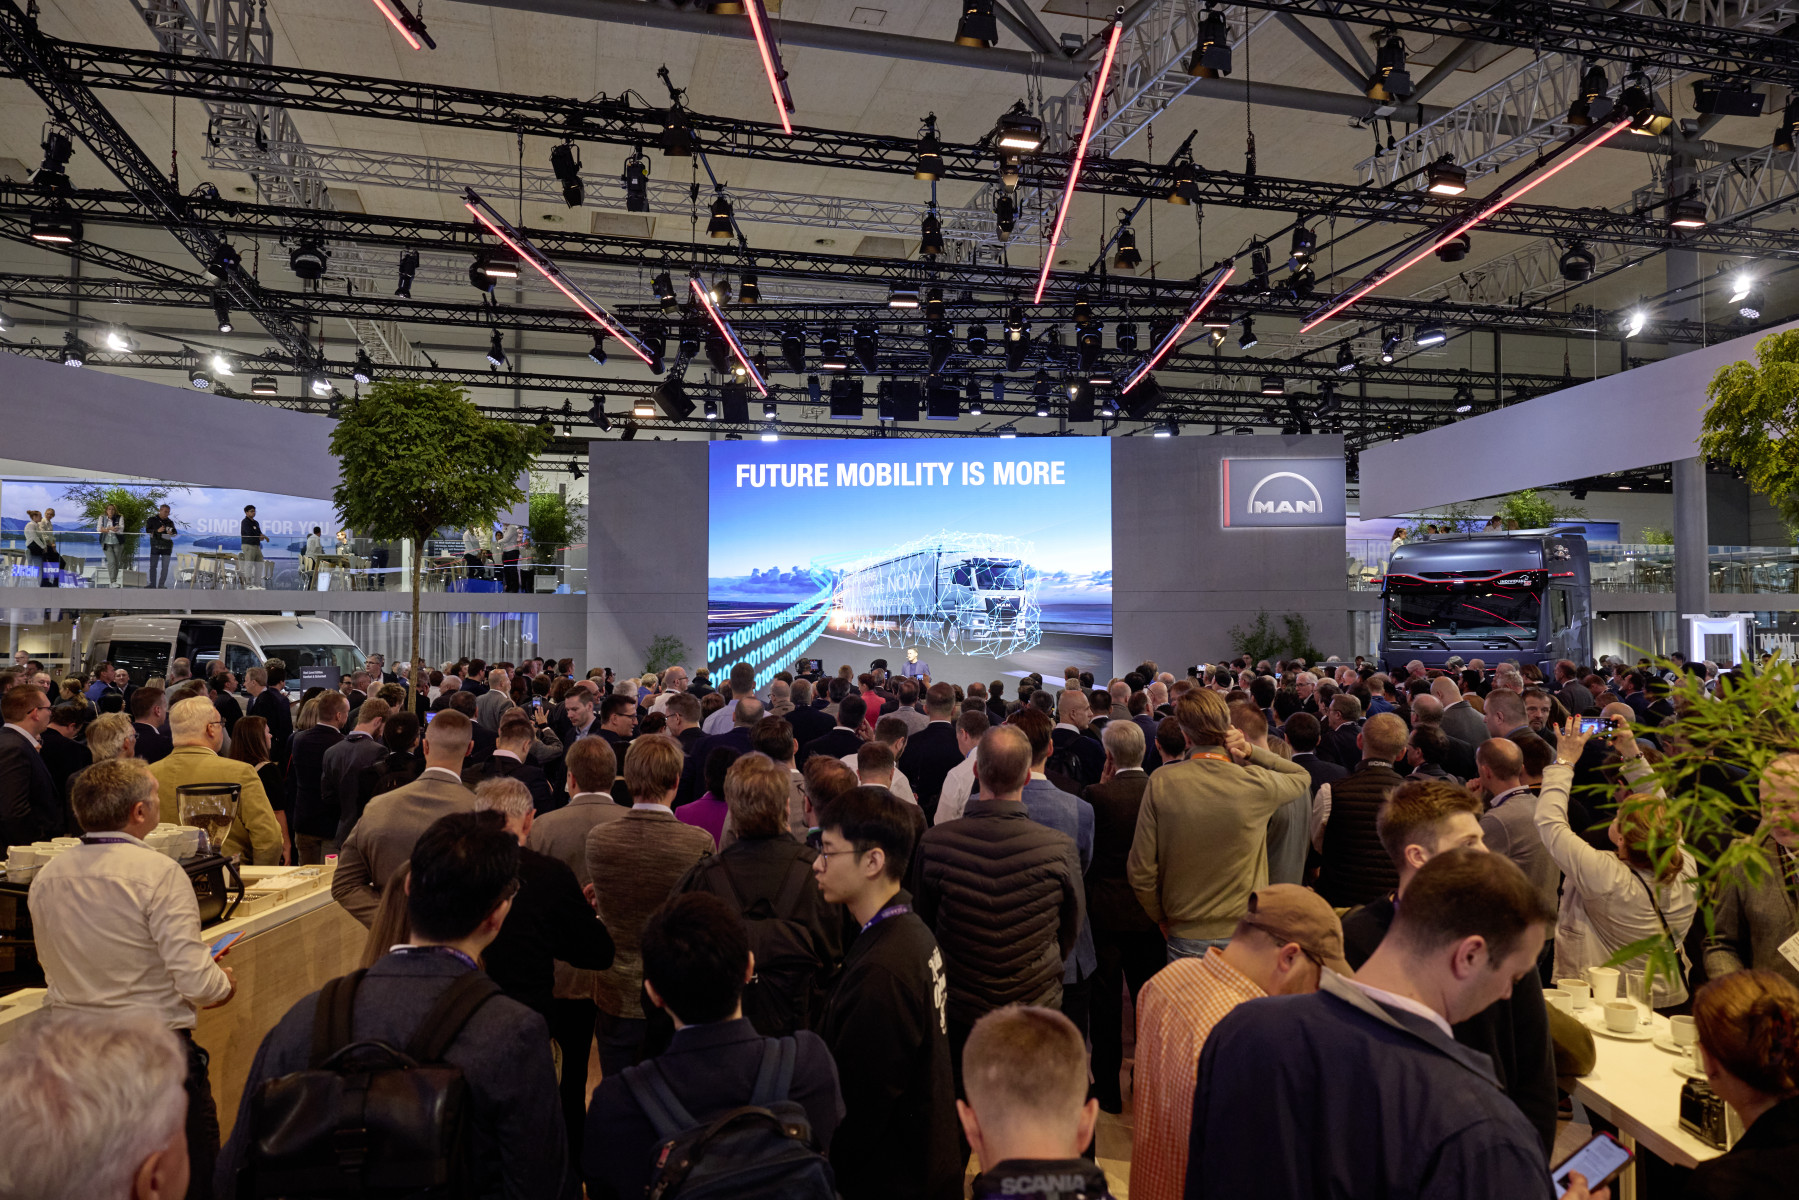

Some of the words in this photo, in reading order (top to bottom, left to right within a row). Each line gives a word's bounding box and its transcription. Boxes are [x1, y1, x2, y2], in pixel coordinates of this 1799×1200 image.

[736, 463, 829, 487] FUTURE
[836, 462, 954, 487] MOBILITY
[962, 461, 985, 486] IS
[993, 461, 1066, 485] MORE
[1254, 500, 1316, 513] MAN
[263, 520, 293, 535] FOR
[888, 570, 923, 592] NOW
[1760, 633, 1791, 650] MAN
[1000, 1174, 1086, 1195] SCANIA
